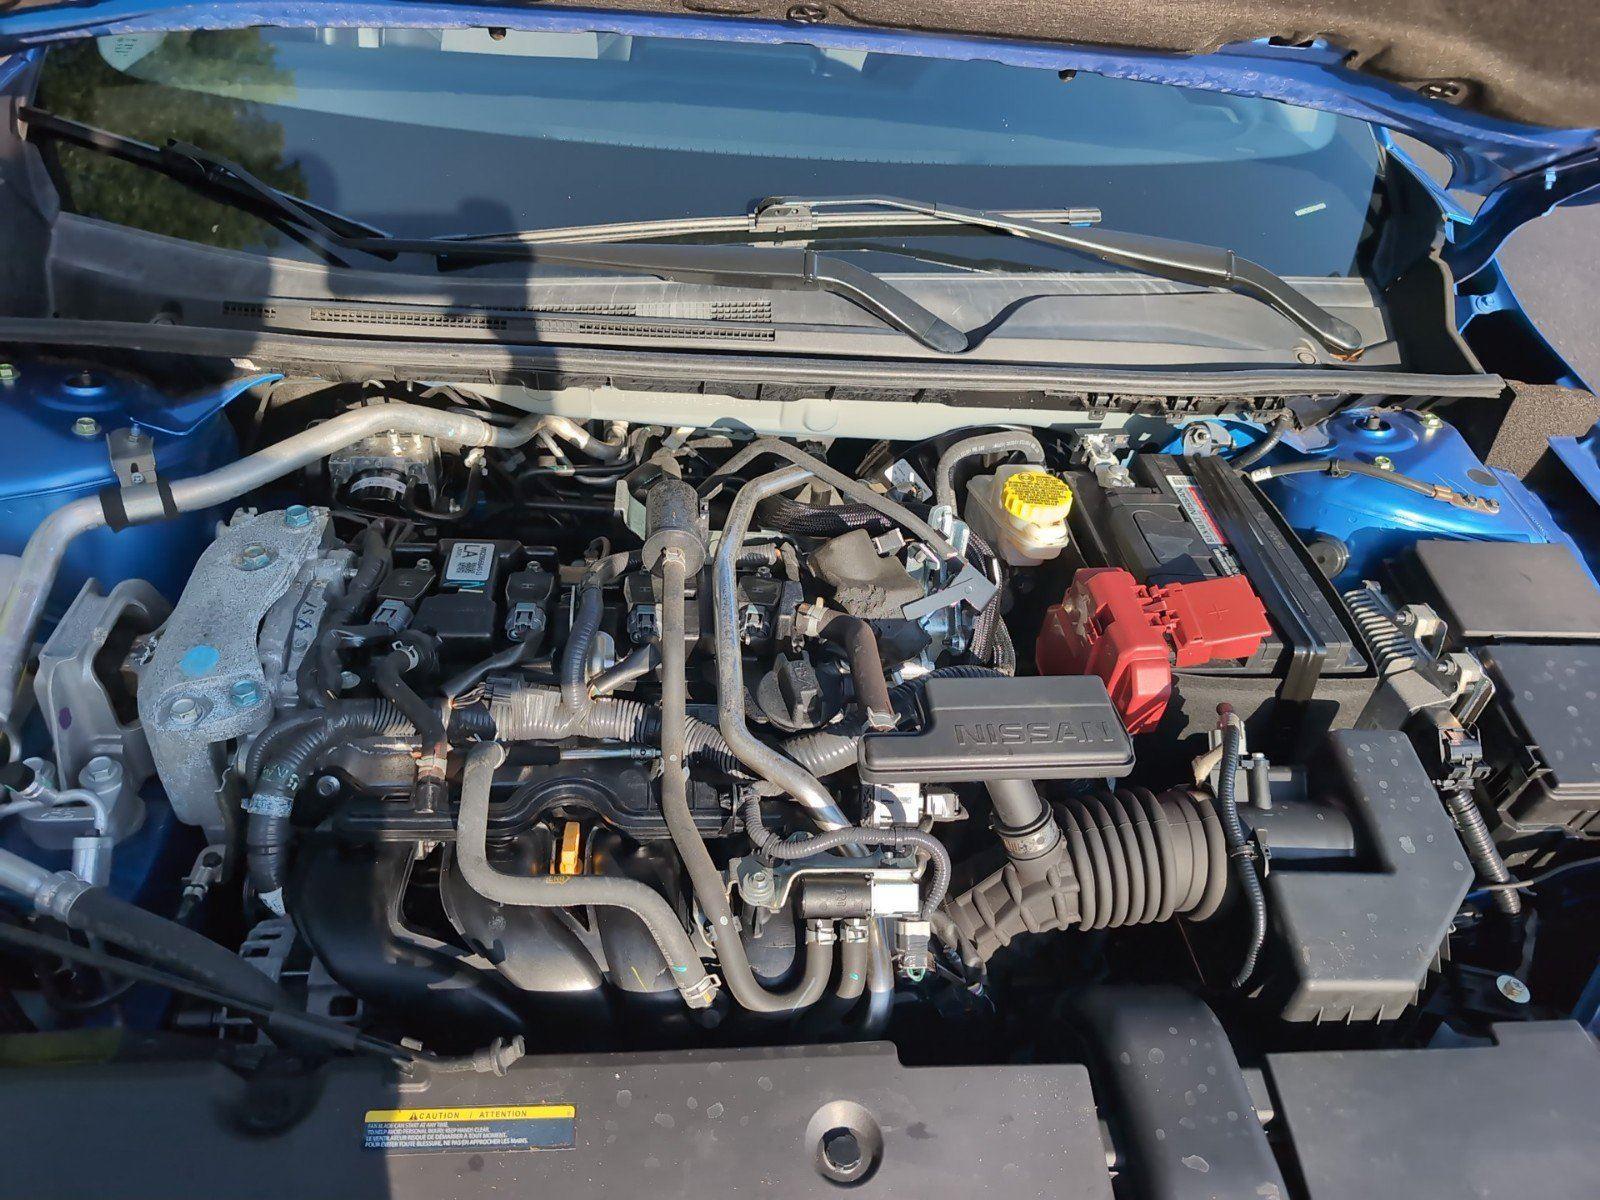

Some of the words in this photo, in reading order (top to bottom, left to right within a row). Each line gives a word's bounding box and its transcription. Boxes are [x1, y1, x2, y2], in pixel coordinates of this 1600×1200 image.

[462, 544, 481, 558] LA
[954, 721, 1114, 746] NISSAN
[420, 1112, 460, 1120] CAUTION
[479, 1110, 527, 1118] ATTENTION
